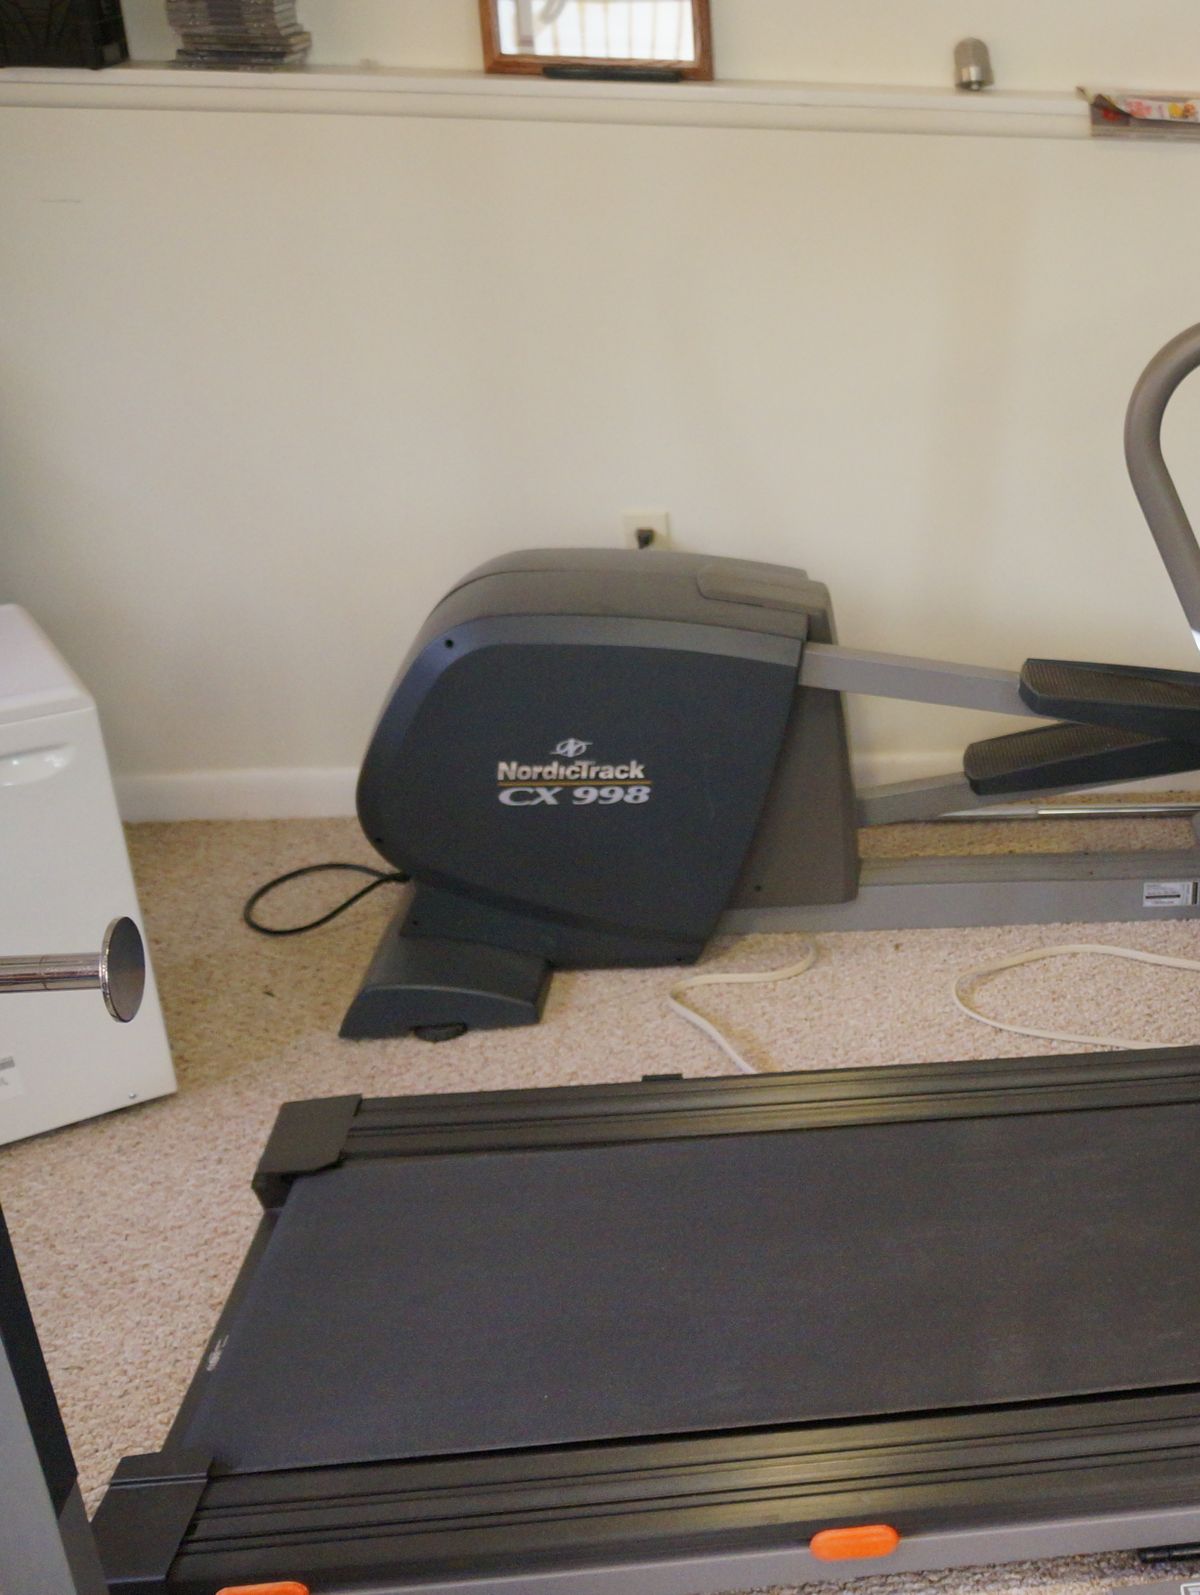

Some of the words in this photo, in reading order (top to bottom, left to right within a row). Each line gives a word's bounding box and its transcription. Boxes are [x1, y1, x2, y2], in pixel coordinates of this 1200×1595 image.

[497, 760, 646, 781] NordicTrack
[498, 787, 563, 806] CX
[572, 785, 652, 805] 998
